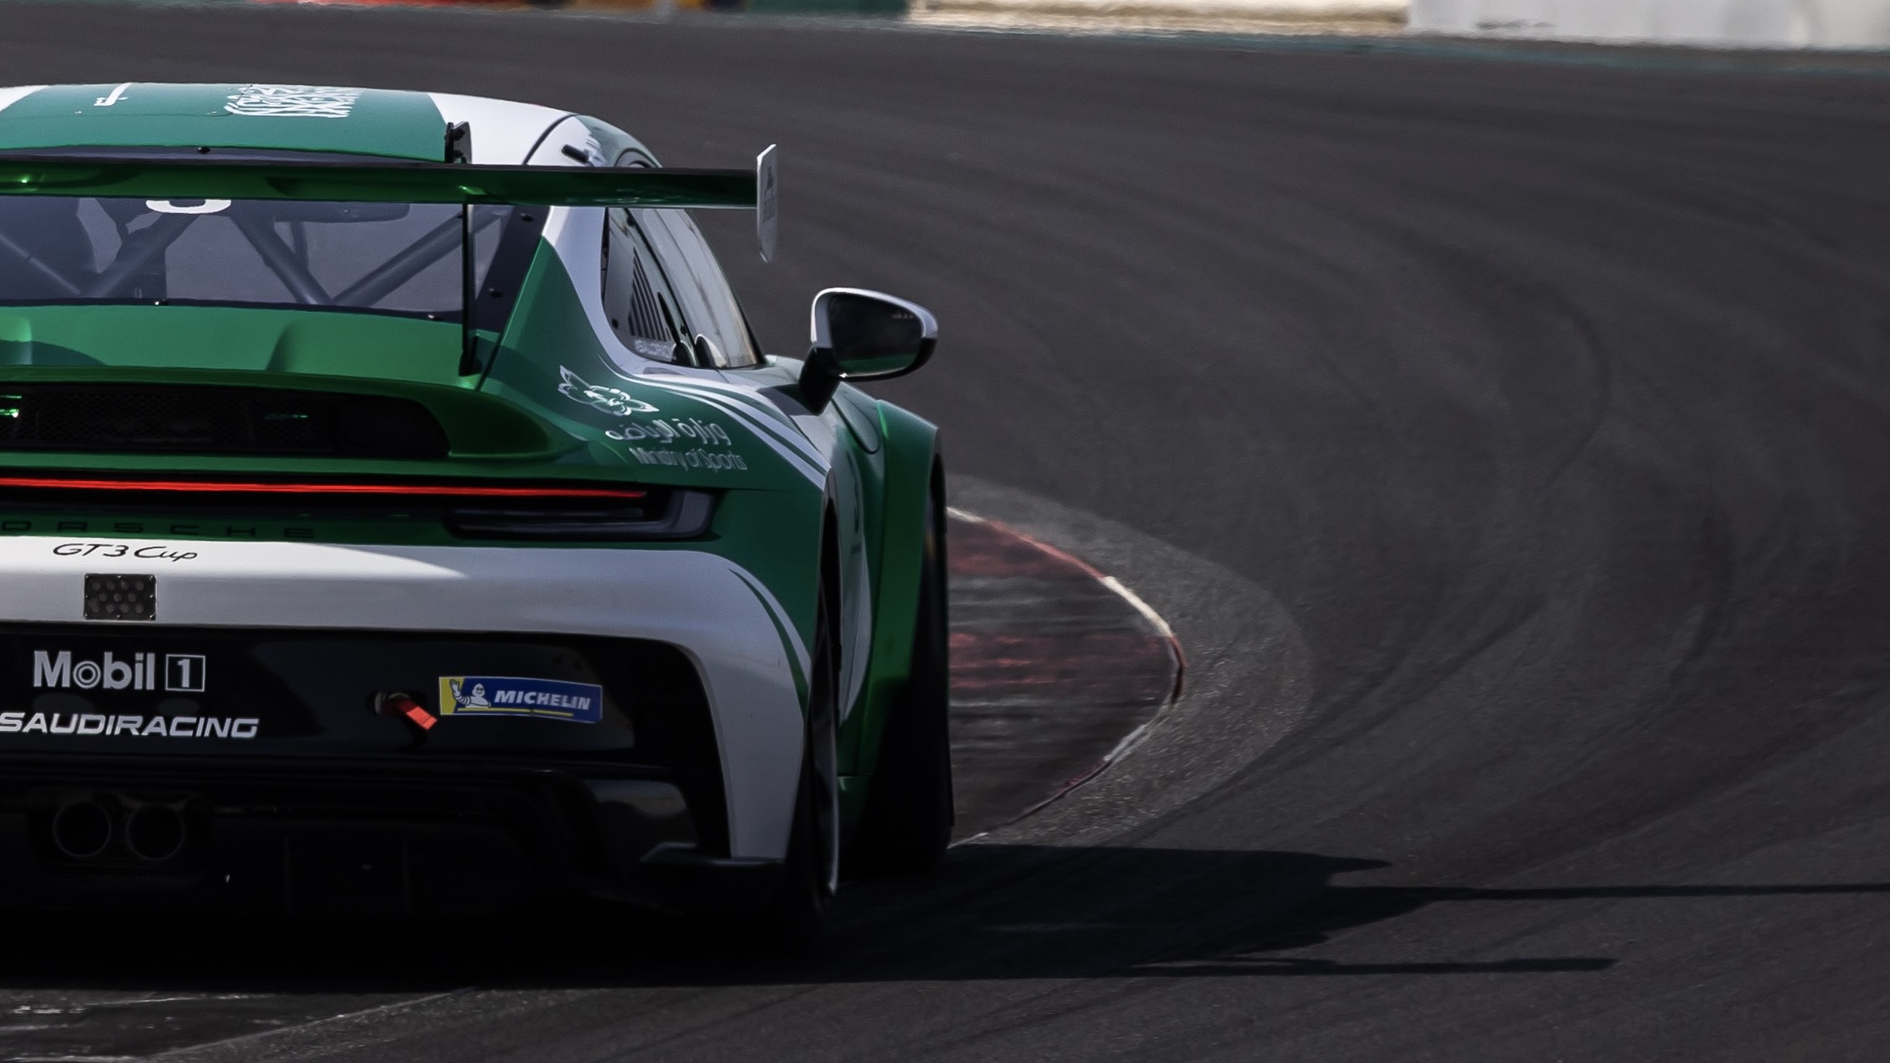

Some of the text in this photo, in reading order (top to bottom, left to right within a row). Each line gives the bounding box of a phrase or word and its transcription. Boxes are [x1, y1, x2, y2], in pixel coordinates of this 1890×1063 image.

[133, 545, 198, 562] Cup
[33, 650, 155, 690] Mobil
[494, 689, 591, 711] MICHELIN
